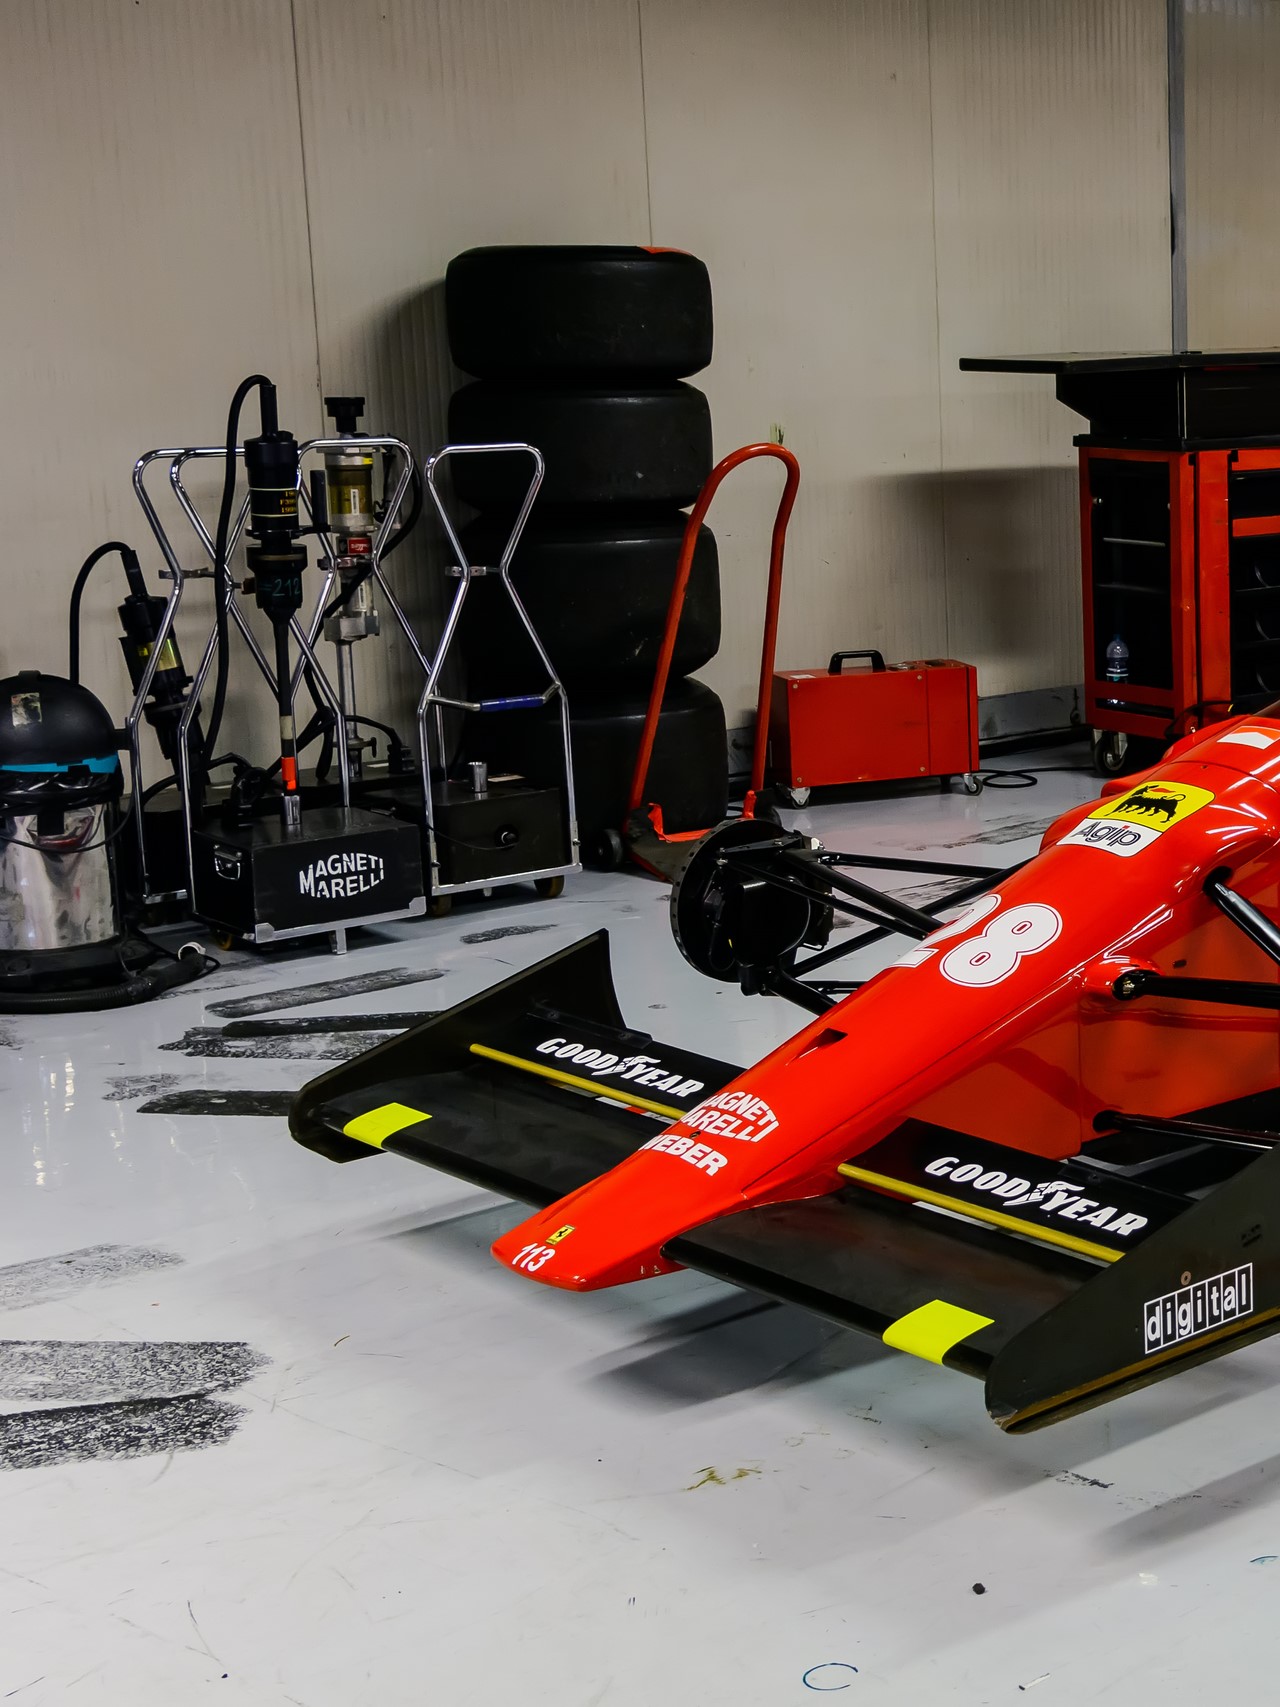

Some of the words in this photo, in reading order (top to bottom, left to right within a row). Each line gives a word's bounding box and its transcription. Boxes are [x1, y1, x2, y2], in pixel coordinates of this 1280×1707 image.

[1070, 821, 1142, 848] Agip
[299, 853, 384, 885] MAGNETI
[299, 868, 384, 898] MARELLI
[512, 1243, 555, 1272] 113
[1146, 1272, 1247, 1343] digital
